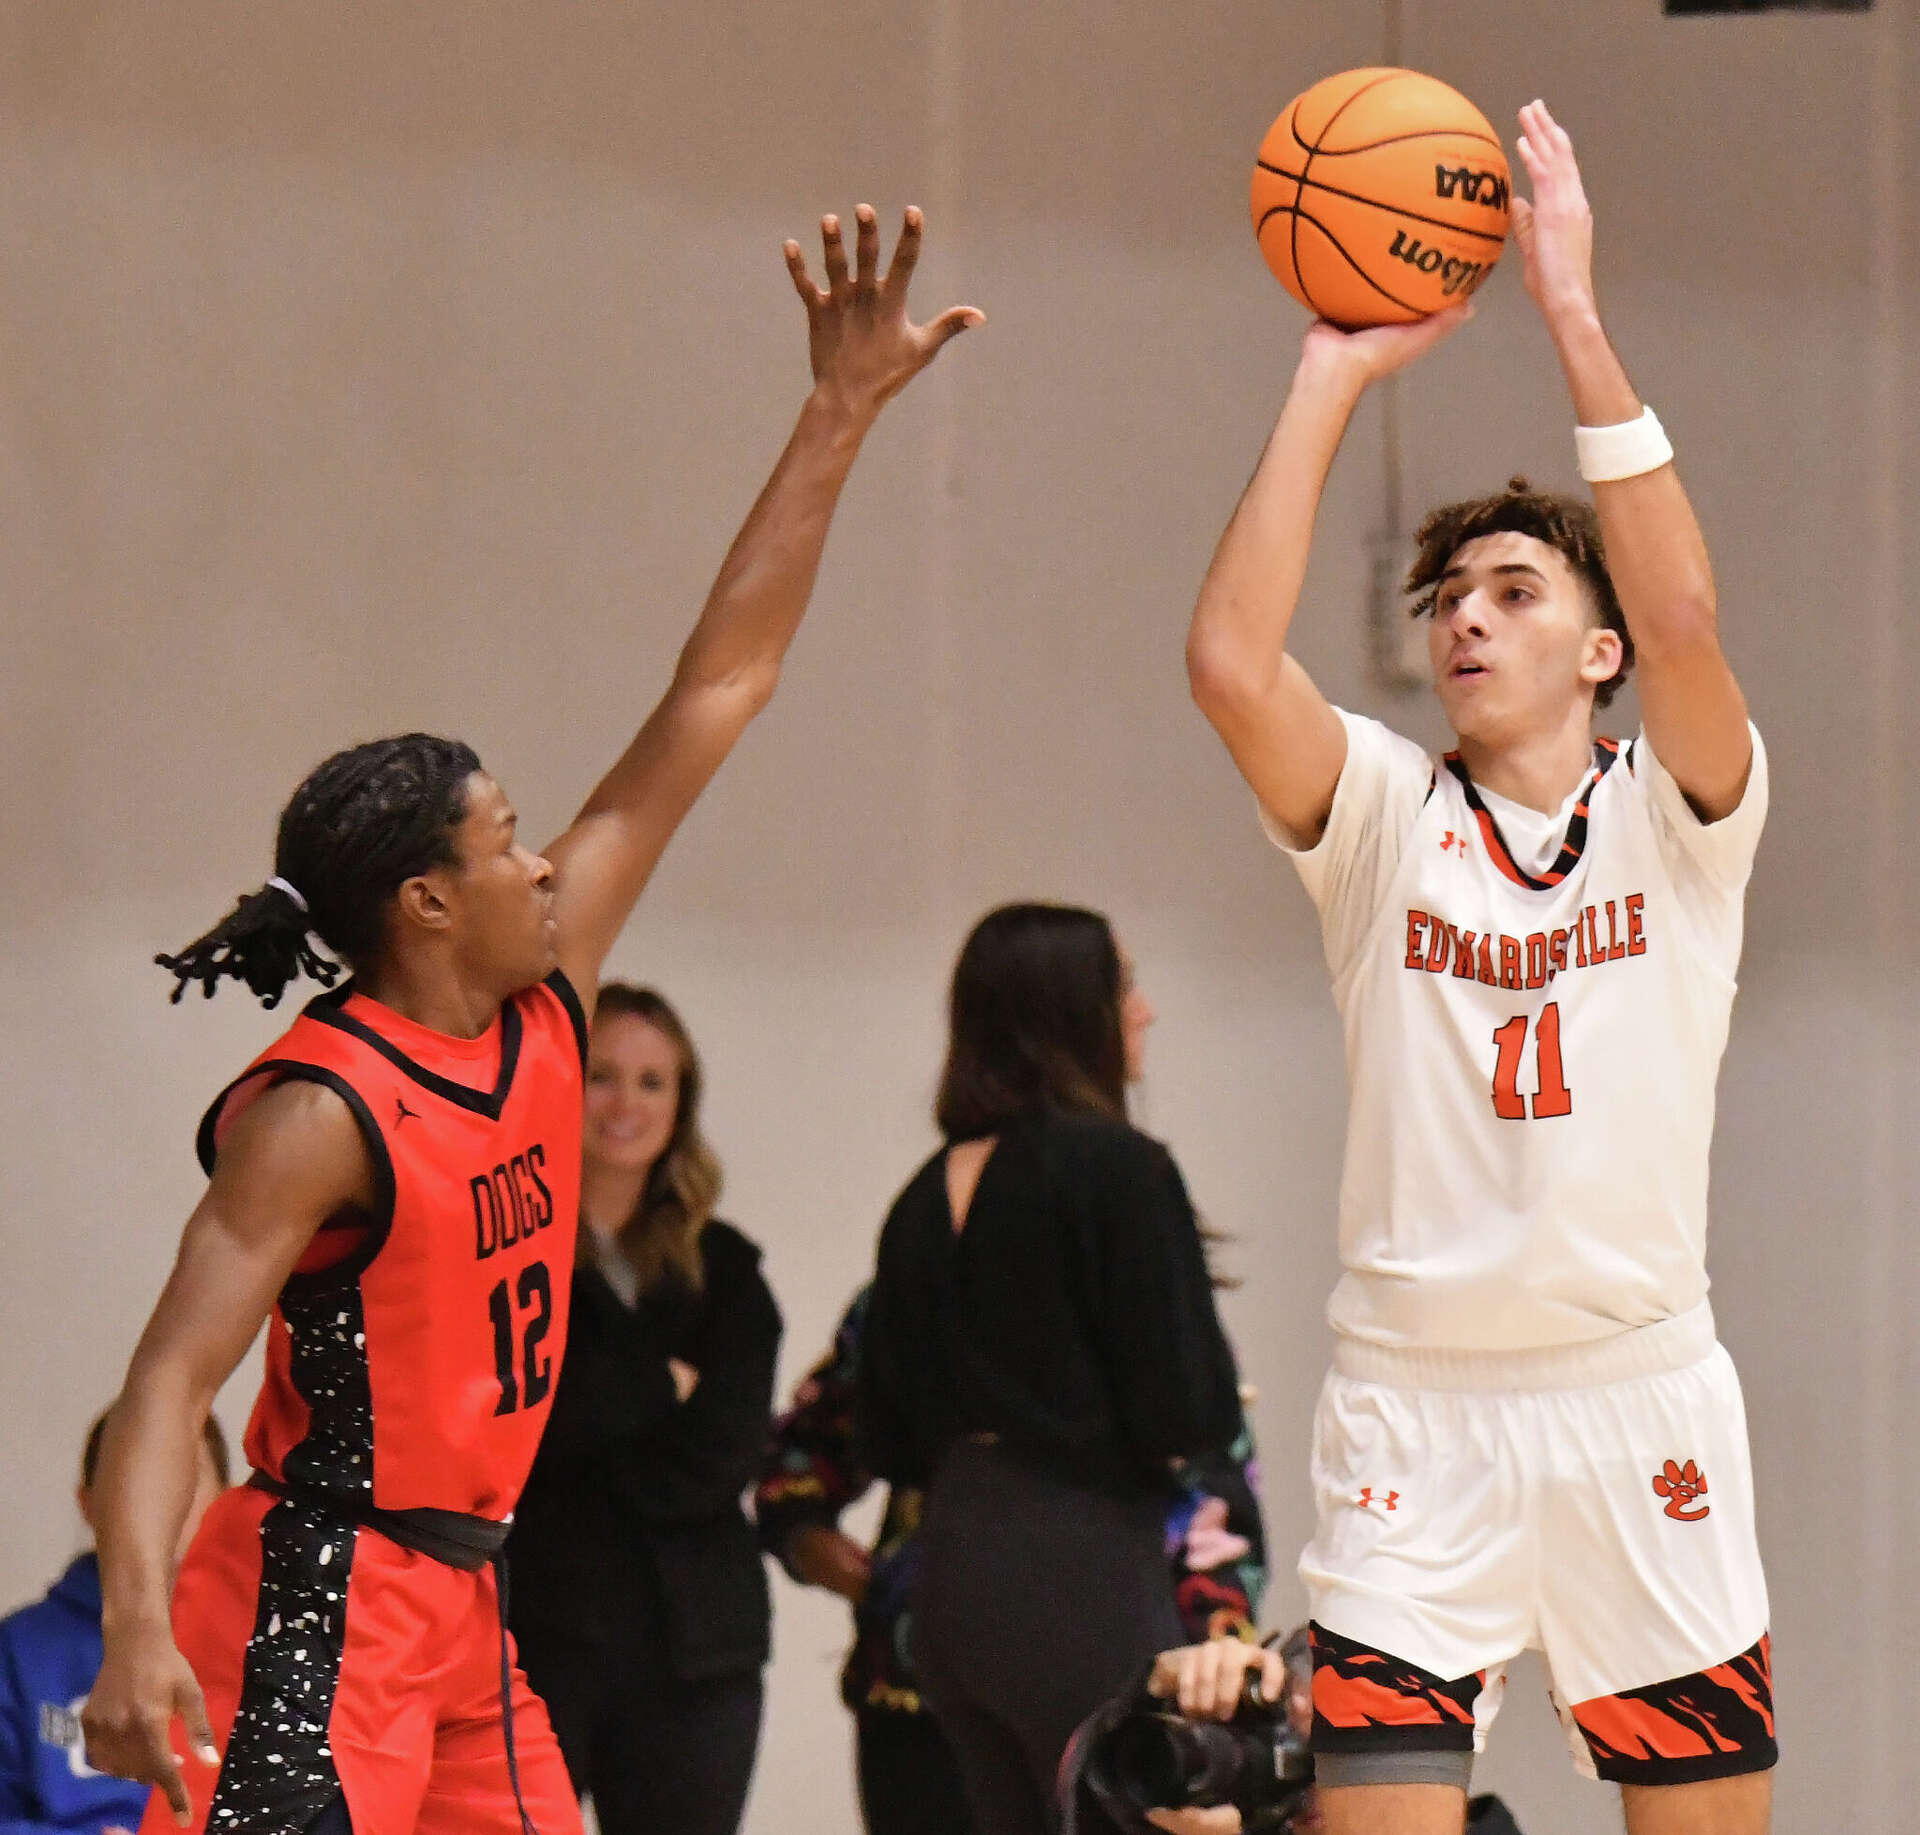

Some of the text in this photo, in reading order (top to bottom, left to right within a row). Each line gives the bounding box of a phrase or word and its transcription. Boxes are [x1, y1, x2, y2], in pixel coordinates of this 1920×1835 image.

[1436, 164, 1510, 215] NCAA
[1389, 230, 1494, 297] ilson
[1491, 1001, 1572, 1120] 11
[470, 1143, 552, 1260] DOGS
[488, 1260, 551, 1417] 12
